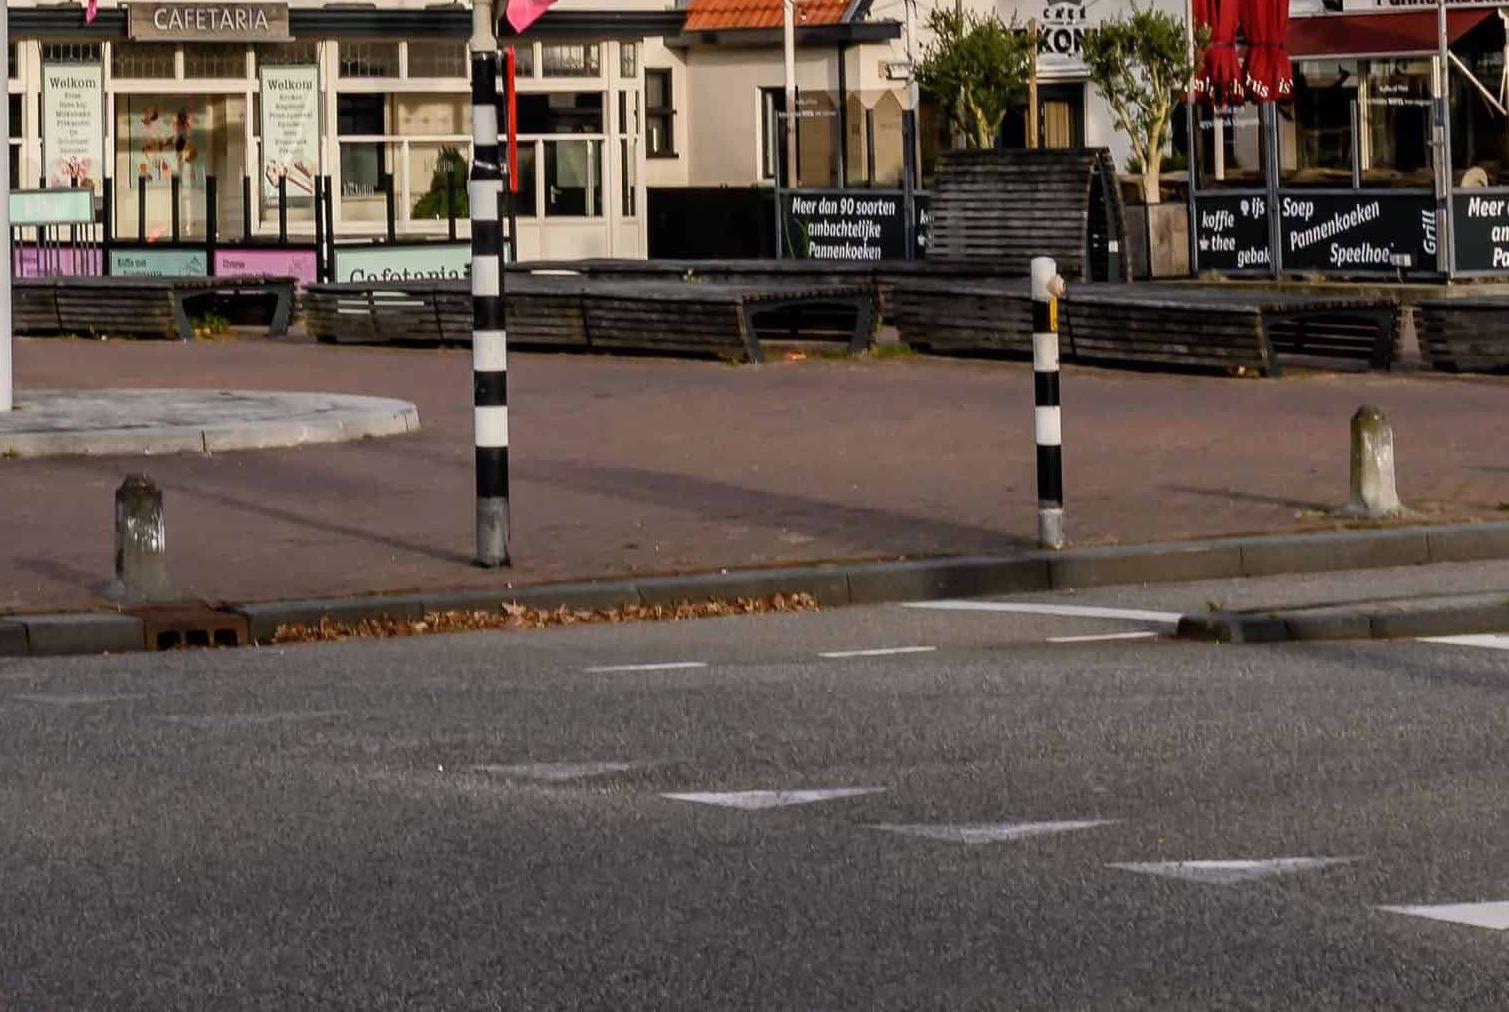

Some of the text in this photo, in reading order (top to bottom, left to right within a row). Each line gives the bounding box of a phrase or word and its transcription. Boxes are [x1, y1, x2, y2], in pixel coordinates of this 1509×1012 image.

[153, 8, 270, 30] CAFETARIA
[49, 76, 97, 89] Welkom
[267, 78, 313, 91] Welkom
[792, 196, 896, 216] Meer dan 90 soorten
[1251, 197, 1265, 219] ijs
[1282, 197, 1314, 221] Soep
[1468, 196, 1505, 218] Meer
[808, 219, 881, 240] ambachtelijke
[1201, 209, 1235, 232] koffie
[1289, 200, 1381, 252] Pannenkoeken
[1211, 234, 1236, 252] thee
[1421, 209, 1437, 255] Grill
[808, 241, 882, 260] Pannenkoeken
